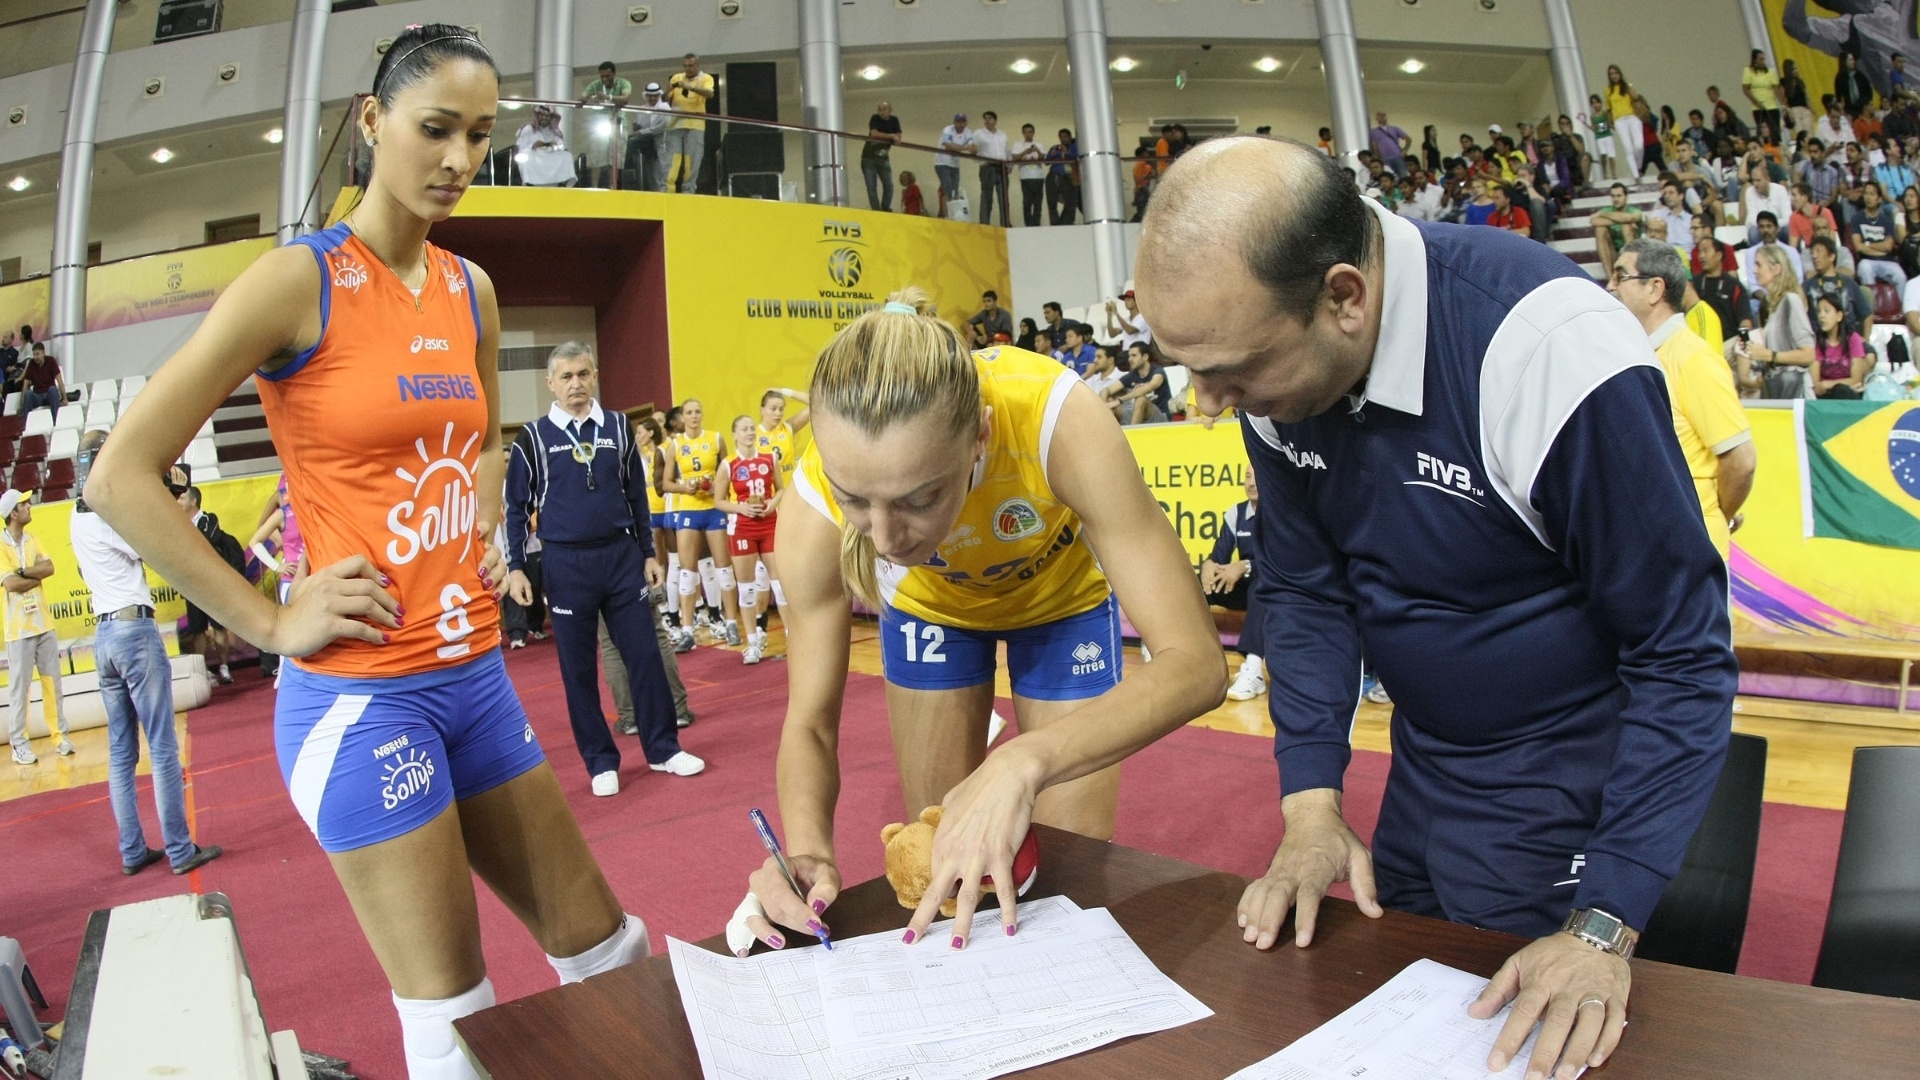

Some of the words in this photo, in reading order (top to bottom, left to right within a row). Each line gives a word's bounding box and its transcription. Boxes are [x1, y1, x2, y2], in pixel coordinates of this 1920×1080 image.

[824, 221, 862, 238] FIVB
[819, 291, 874, 300] VOLLEYBALL
[747, 299, 782, 318] CLUB
[787, 300, 832, 319] WORLD
[424, 338, 449, 351] asics
[692, 457, 702, 472] 5
[1417, 451, 1471, 491] FIVB
[746, 478, 765, 496] 18
[387, 479, 479, 565] Solly
[736, 540, 749, 551] 18
[900, 621, 946, 663] 12
[1072, 659, 1106, 676] errea
[382, 758, 435, 811] Sollys
